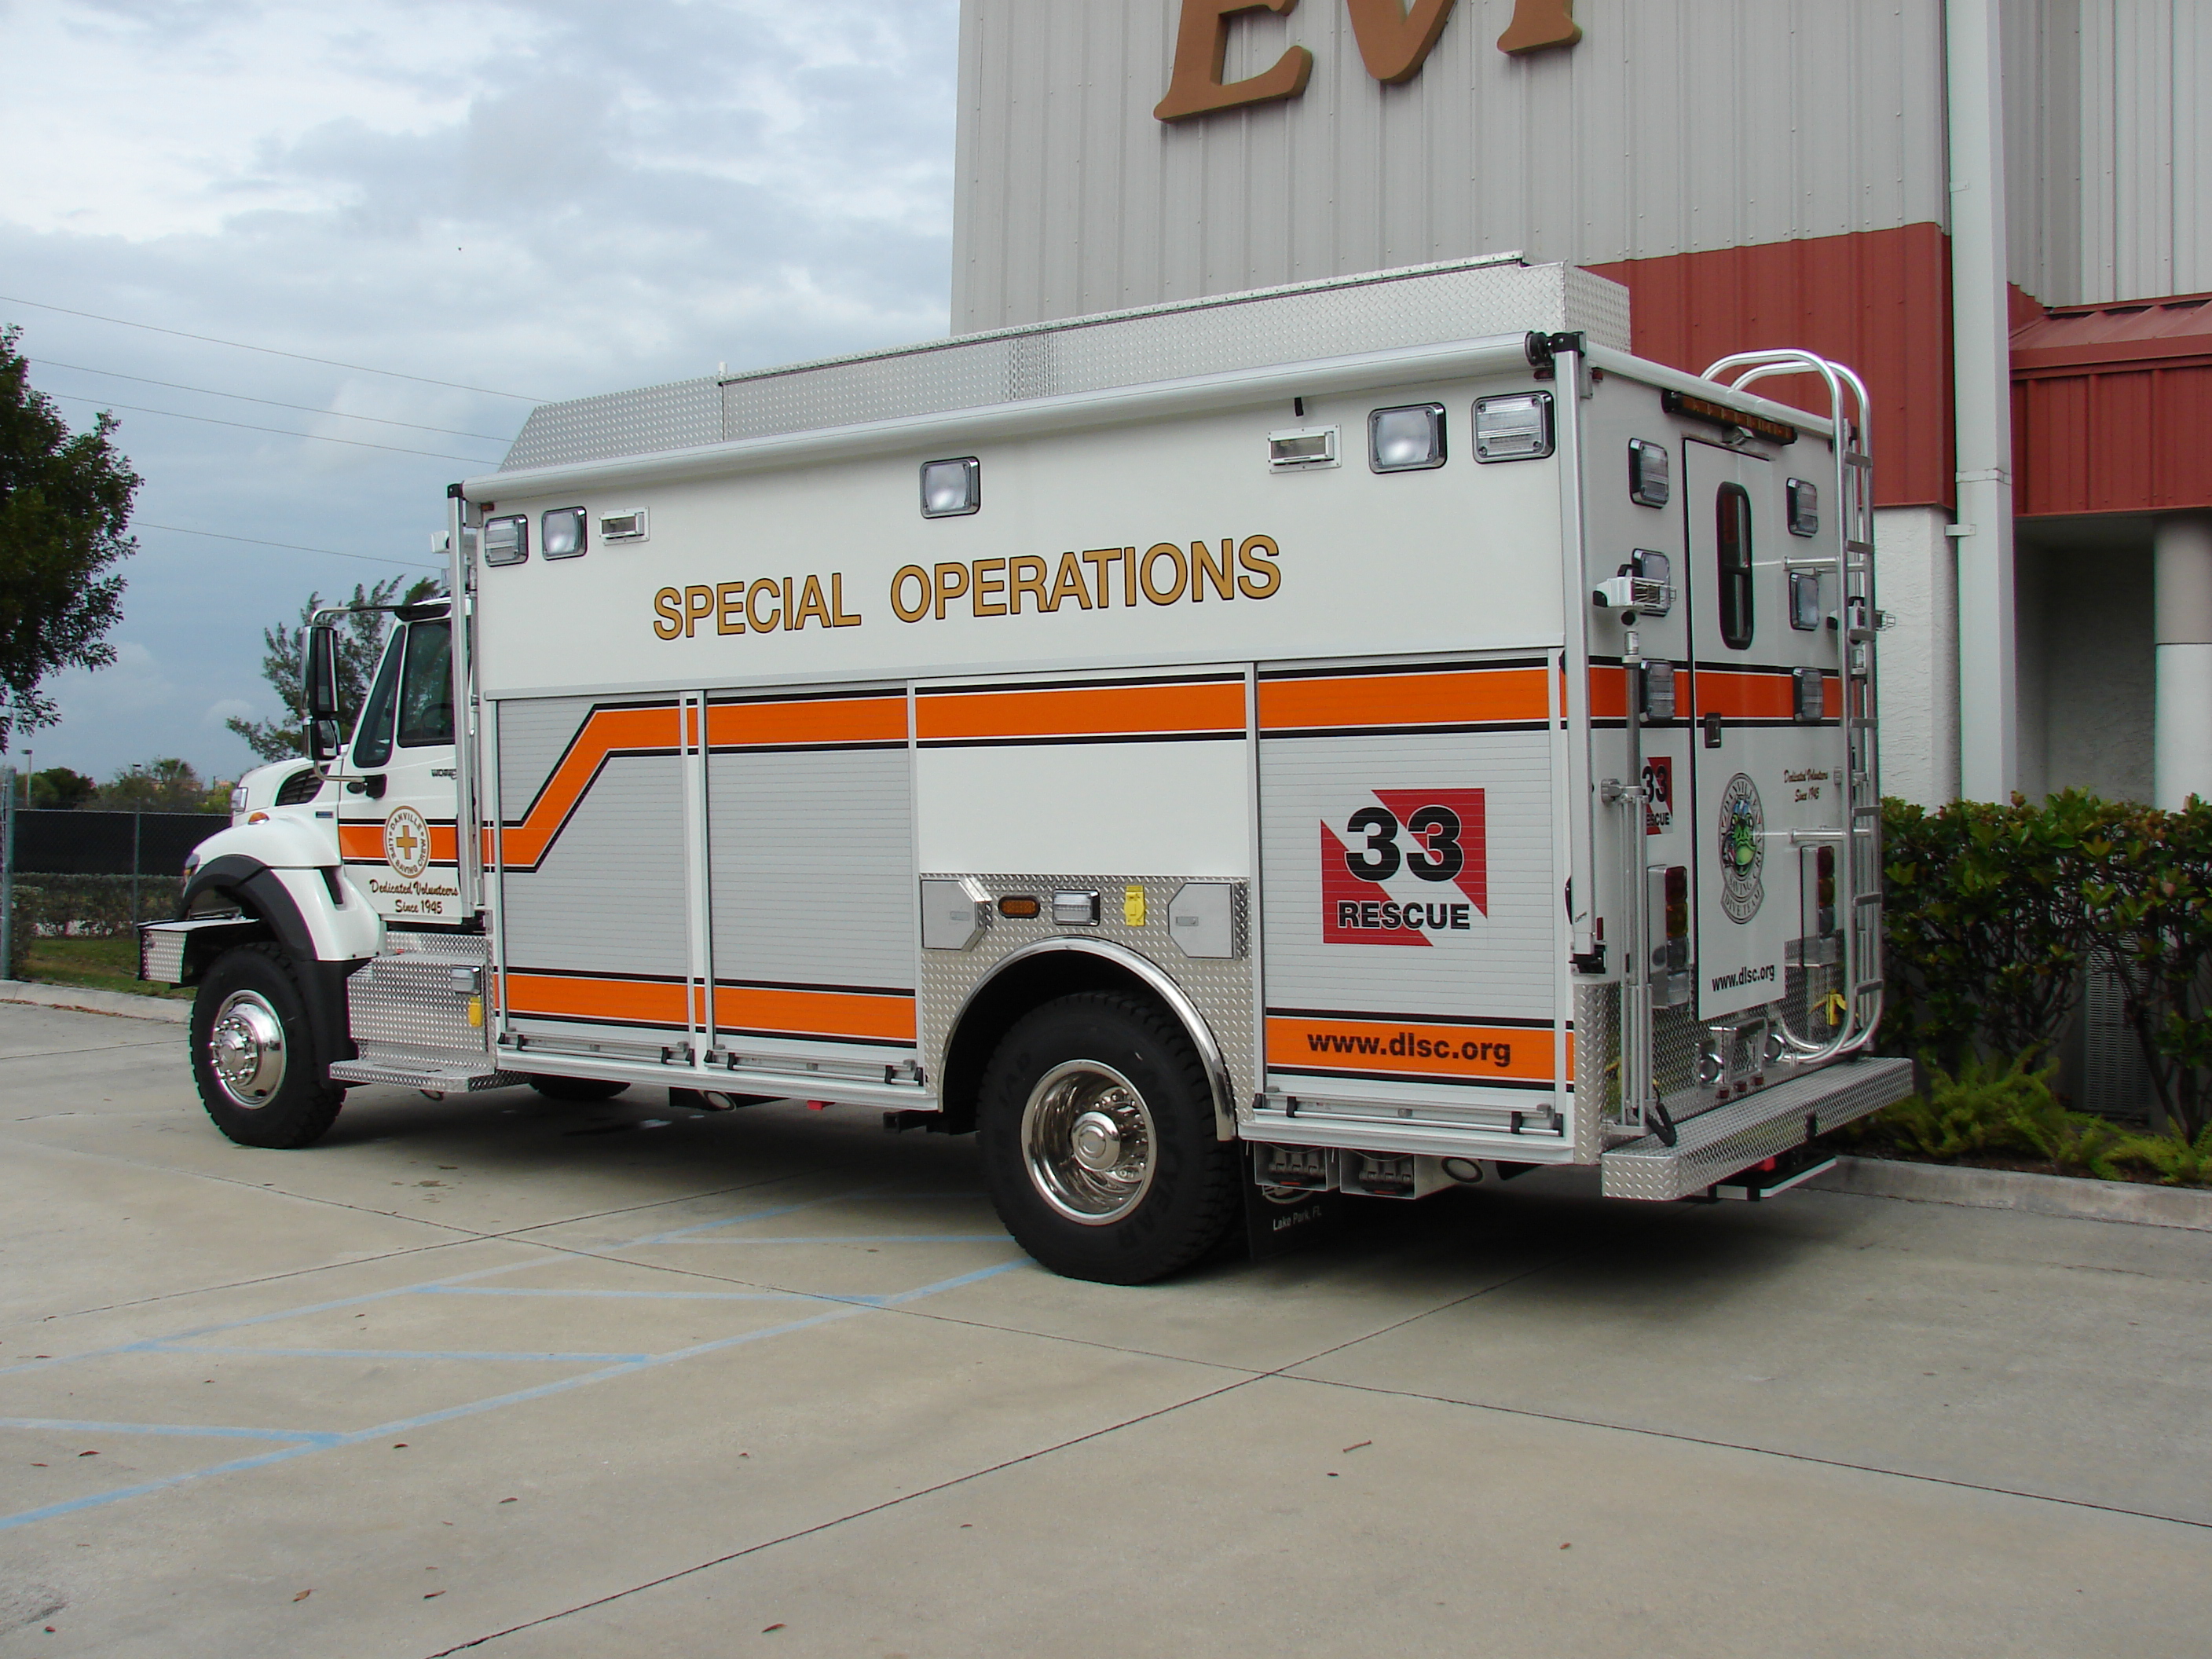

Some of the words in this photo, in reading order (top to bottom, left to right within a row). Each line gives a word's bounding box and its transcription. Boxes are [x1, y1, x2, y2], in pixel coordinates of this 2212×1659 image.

[653, 572, 862, 641] SPECIAL
[890, 534, 1282, 623] OPERATIONS
[1642, 765, 1667, 803] 33
[390, 812, 423, 832] DANVILLE
[1646, 812, 1670, 826] ESCUE
[1345, 805, 1464, 882] 33
[395, 859, 419, 874] SAVING
[369, 879, 412, 894] Dedicated
[413, 881, 459, 896] Volunteers
[395, 899, 419, 913] Since
[420, 899, 443, 914] 1945
[1337, 900, 1471, 931] RESCUE
[1711, 964, 1774, 992] www.dlsc.org
[1306, 1031, 1512, 1068] www.dlsc.org
[1273, 1214, 1292, 1231] Lake
